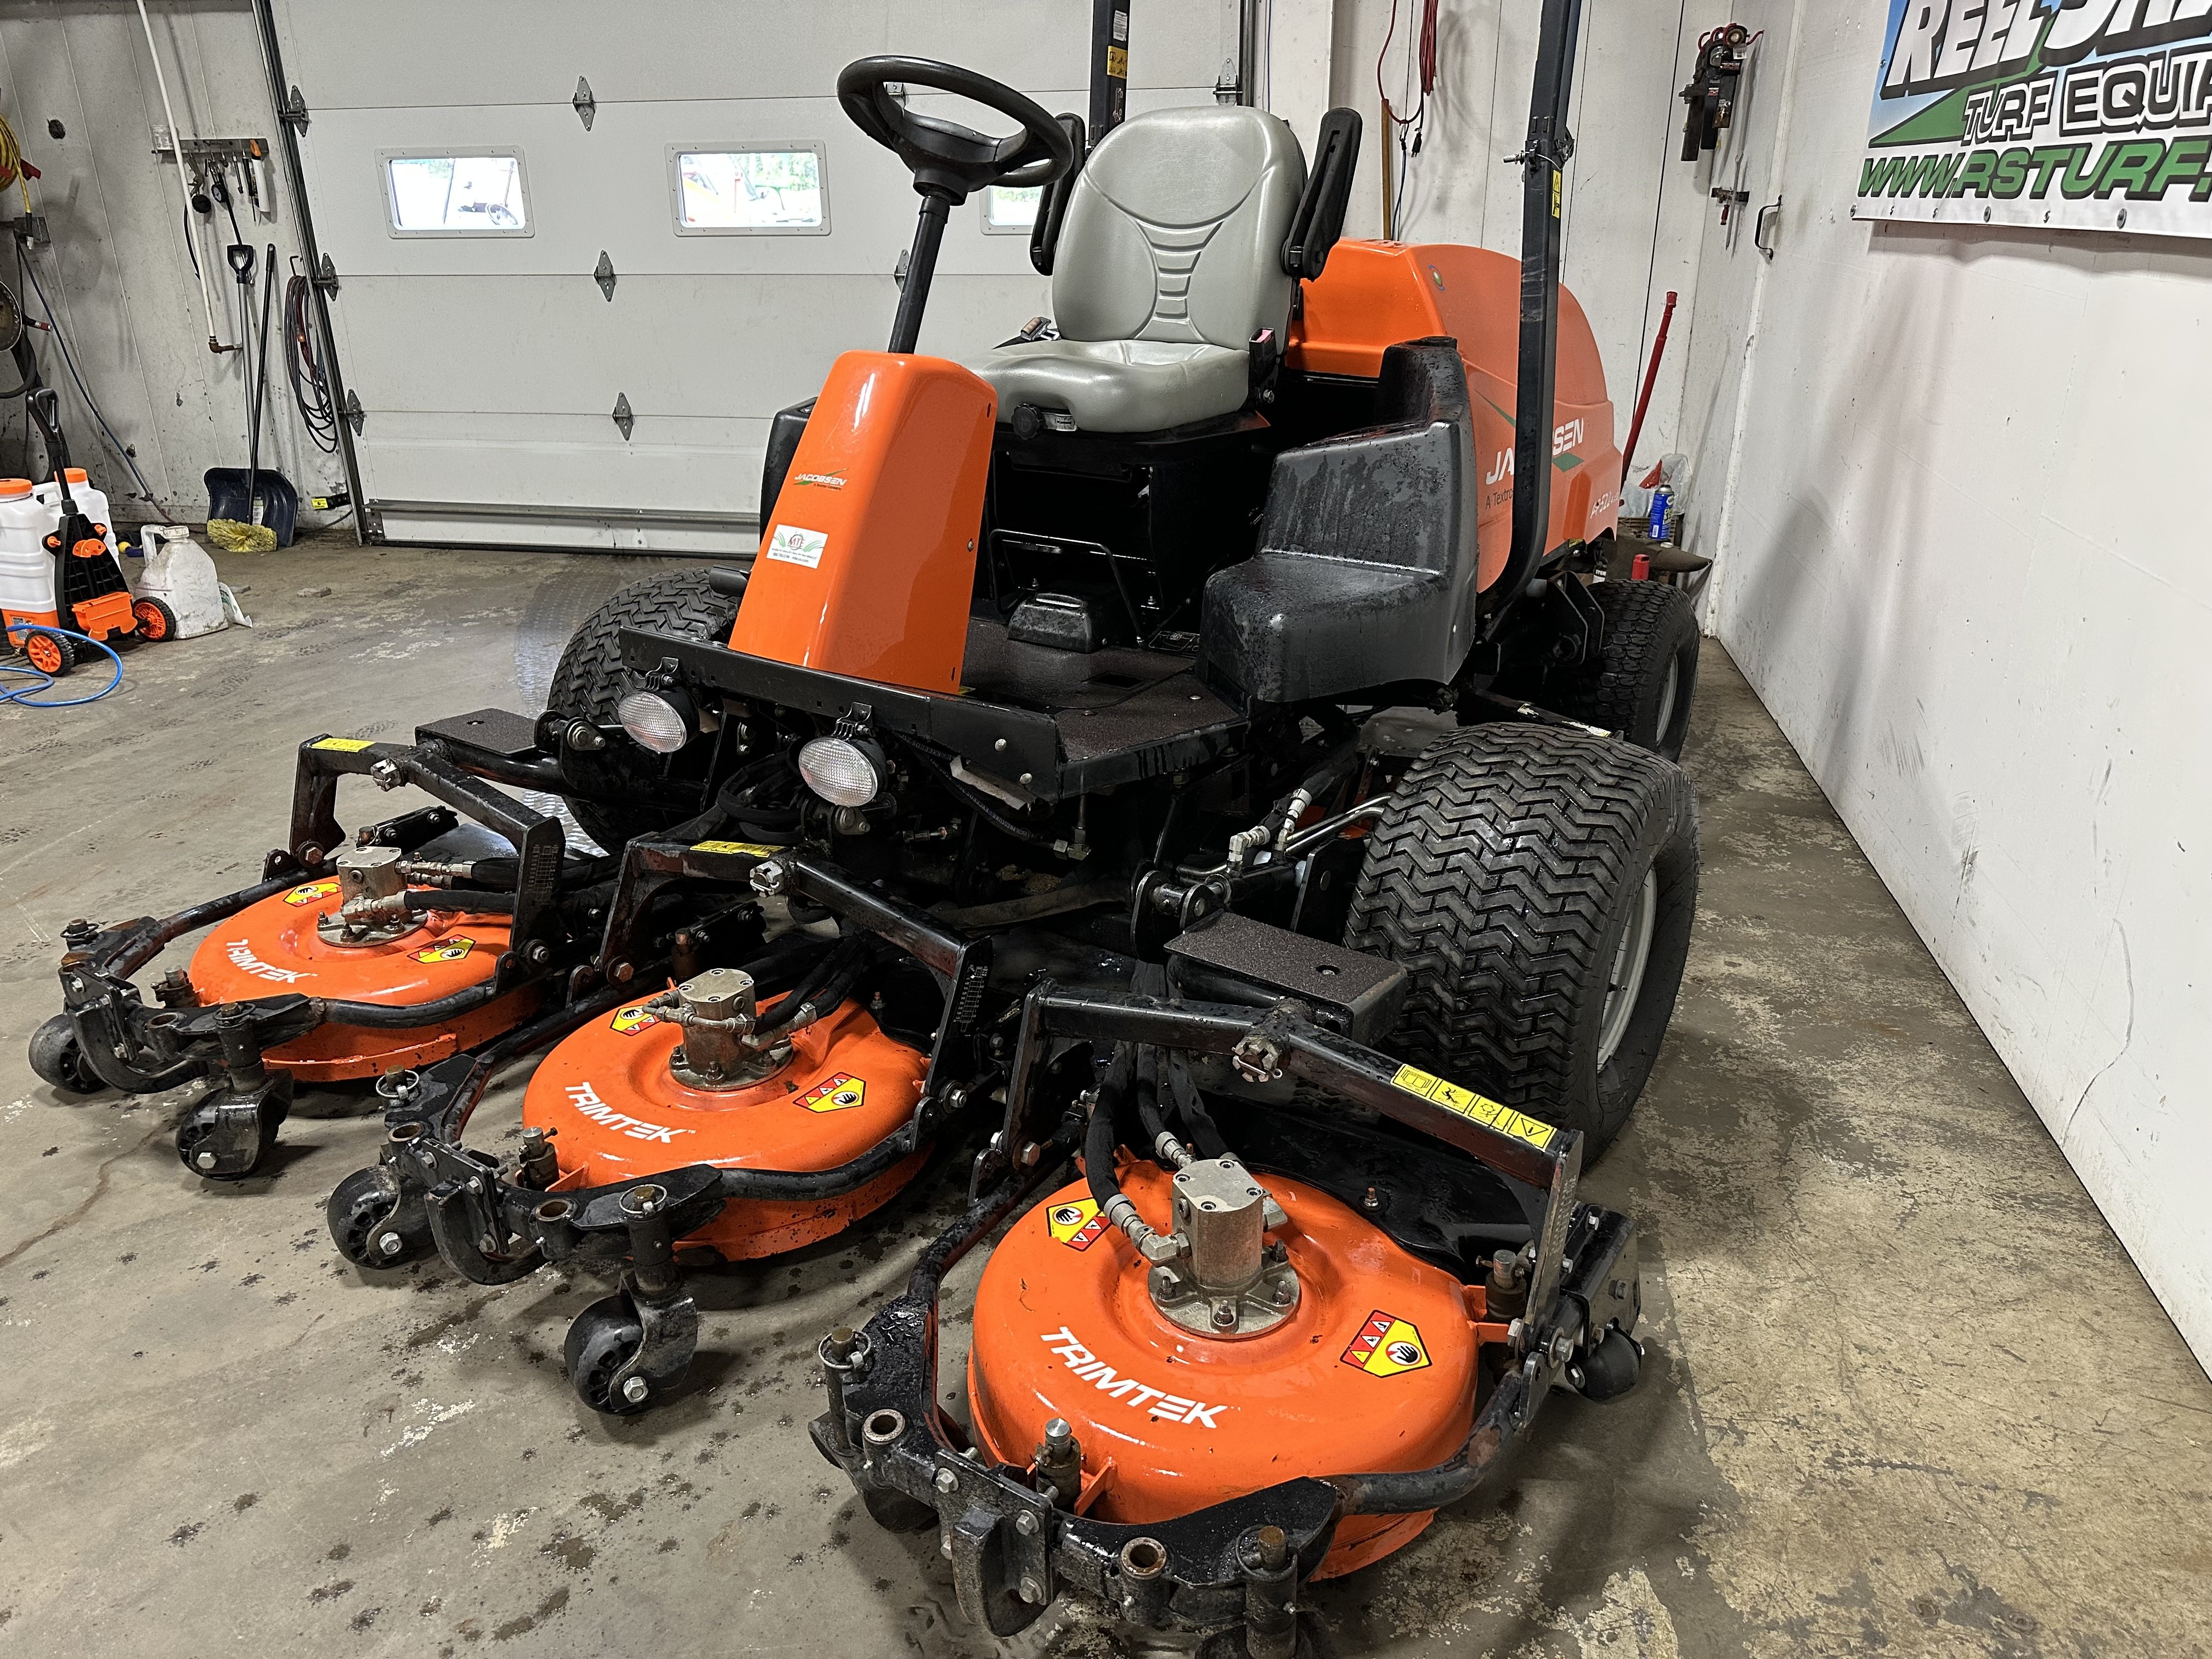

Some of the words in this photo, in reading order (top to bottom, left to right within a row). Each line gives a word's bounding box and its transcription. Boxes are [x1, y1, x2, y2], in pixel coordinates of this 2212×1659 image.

[1965, 79, 2055, 142] TURF
[794, 473, 848, 487] JACOBSEN
[1485, 495, 1491, 510] A
[1493, 488, 1513, 505] Textro
[226, 939, 308, 984] TRIMTEK
[565, 1082, 687, 1143] TRIMTEK
[1041, 1327, 1228, 1429] TRIMTEK
